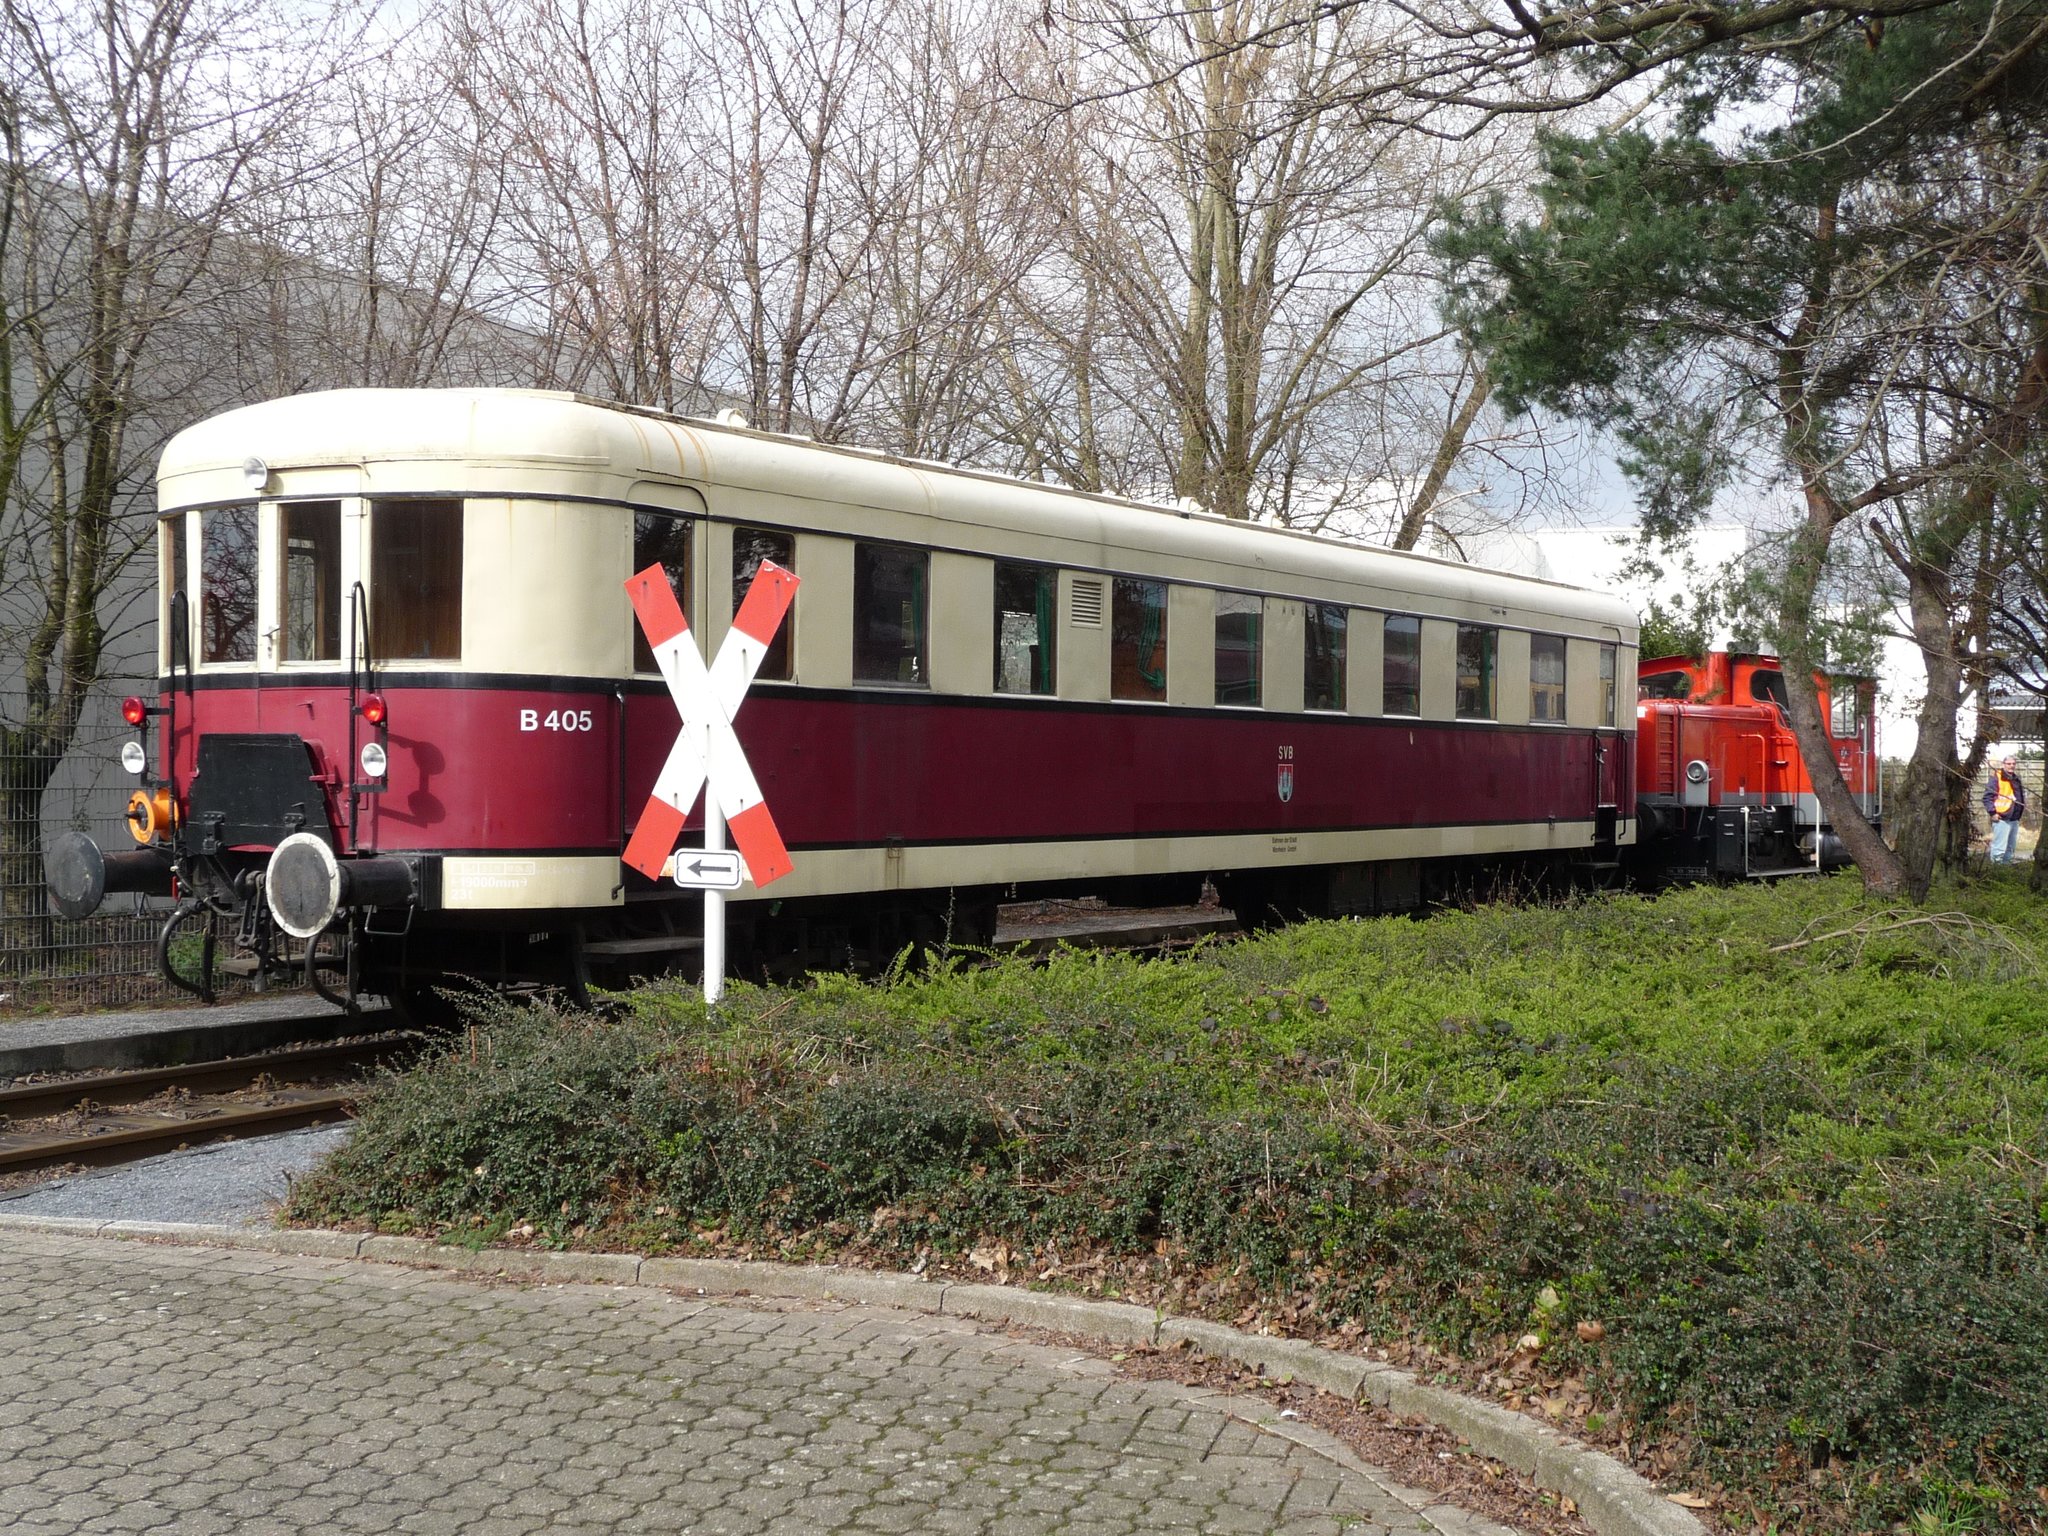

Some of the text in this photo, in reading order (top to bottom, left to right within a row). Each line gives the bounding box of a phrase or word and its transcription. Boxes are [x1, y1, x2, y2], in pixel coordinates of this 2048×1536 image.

[520, 709, 593, 732] B 405
[1278, 745, 1294, 760] SVB
